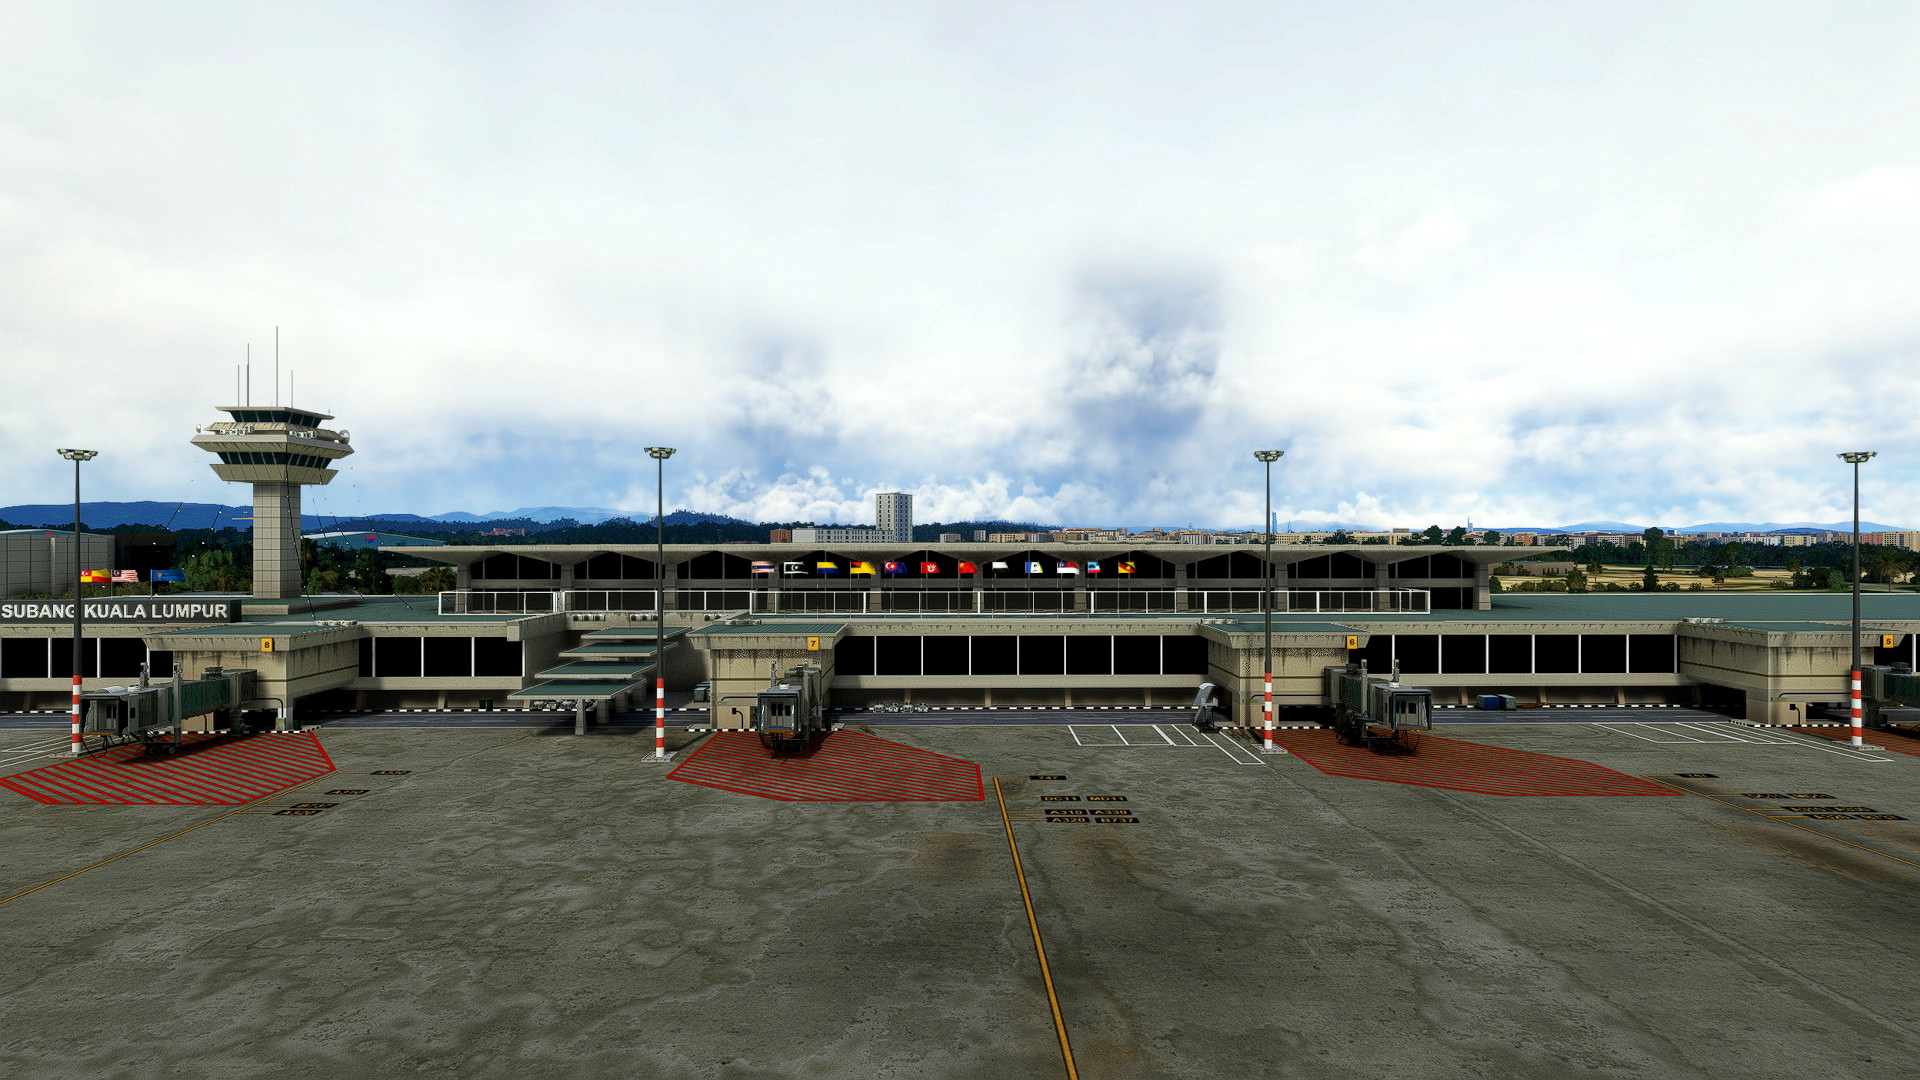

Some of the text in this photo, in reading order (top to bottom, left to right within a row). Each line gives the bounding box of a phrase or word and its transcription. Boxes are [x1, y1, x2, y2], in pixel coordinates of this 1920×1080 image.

[1, 603, 228, 619] SUBANG KUALA LUMPUR
[264, 641, 270, 649] 8
